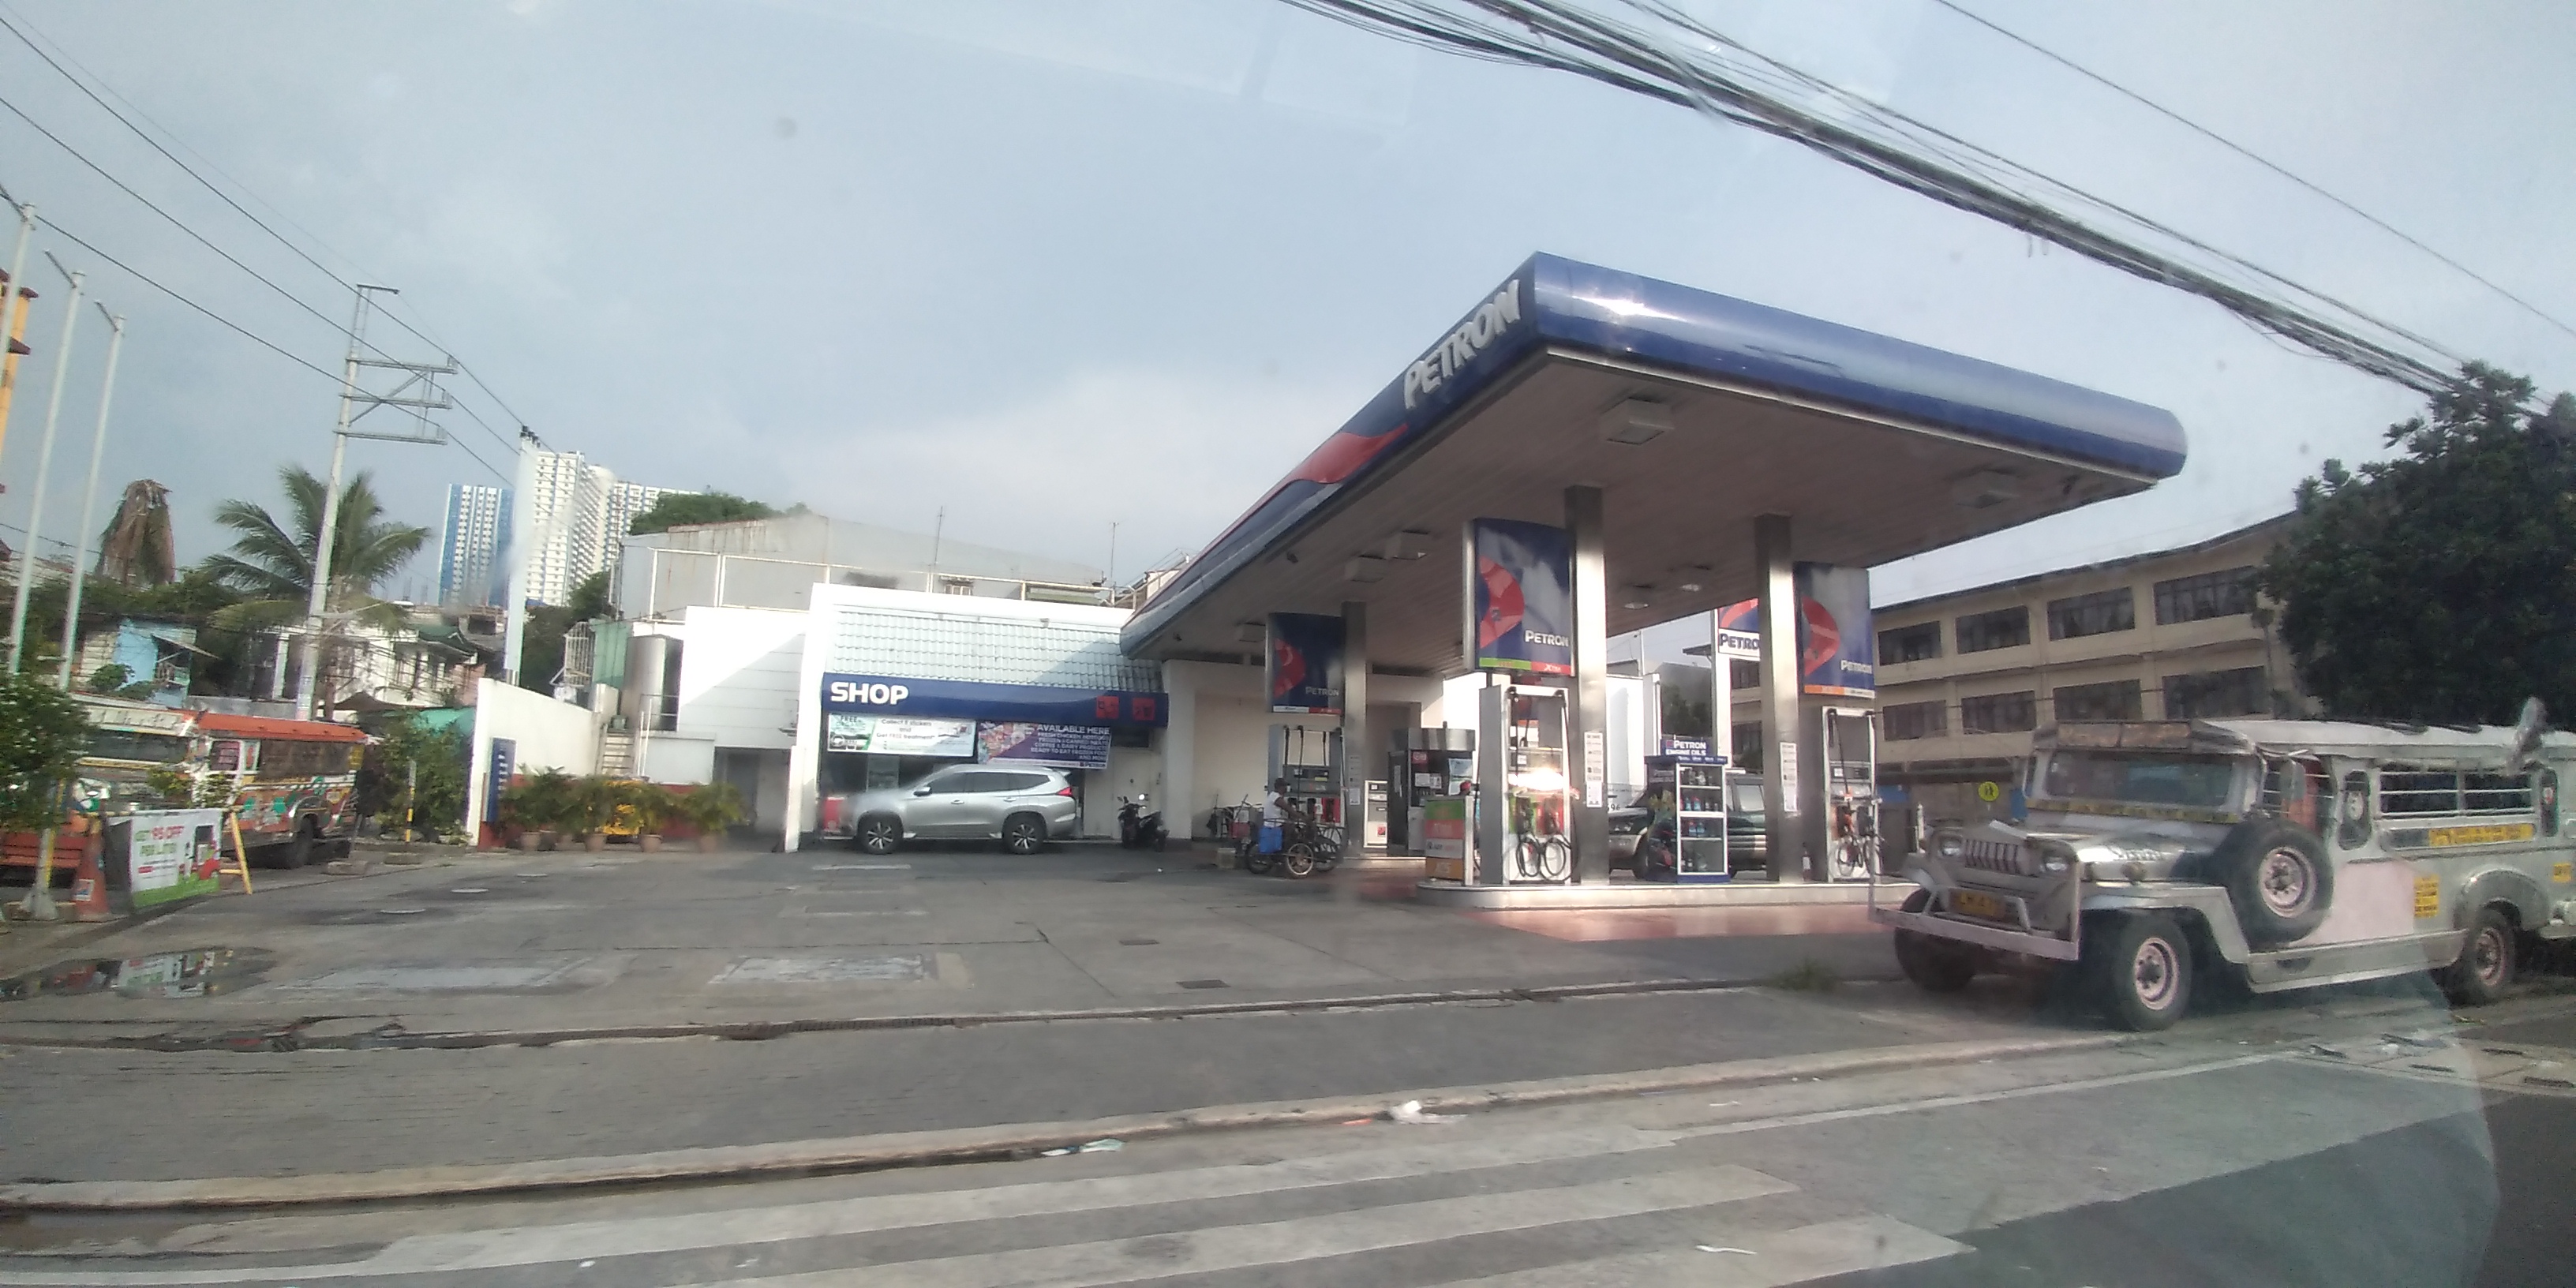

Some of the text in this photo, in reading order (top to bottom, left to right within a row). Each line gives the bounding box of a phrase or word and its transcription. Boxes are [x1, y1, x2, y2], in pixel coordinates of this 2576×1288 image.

[1404, 279, 1521, 409] PETRON
[1525, 630, 1569, 647] PETRON
[1719, 633, 1759, 650] PETRO
[1840, 660, 1872, 674] PETRON
[830, 681, 909, 706] SHOP
[1305, 687, 1339, 695] PETRON
[1037, 724, 1086, 734] AVAILABLE
[1674, 740, 1706, 749] PETRON
